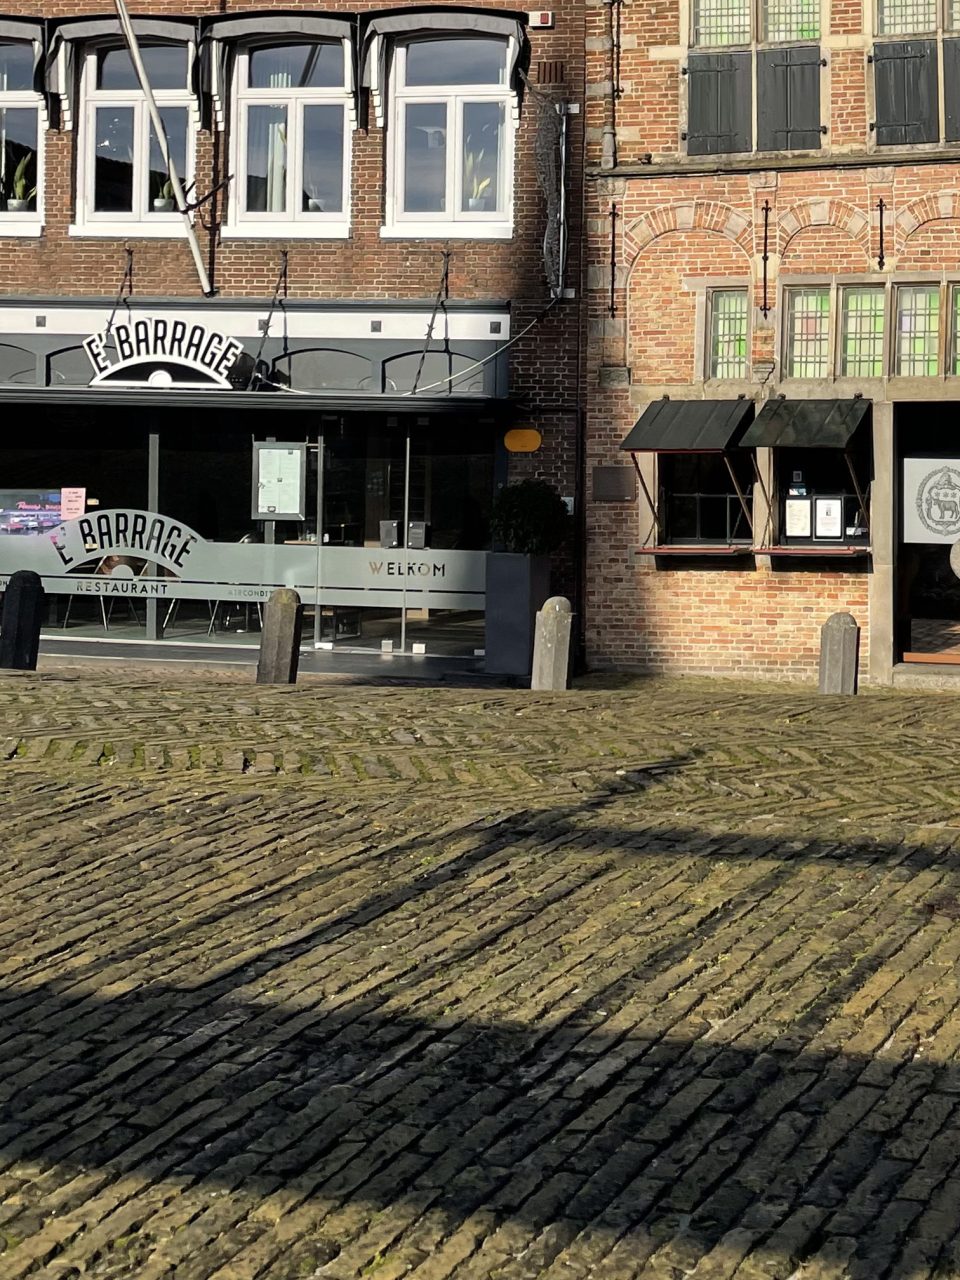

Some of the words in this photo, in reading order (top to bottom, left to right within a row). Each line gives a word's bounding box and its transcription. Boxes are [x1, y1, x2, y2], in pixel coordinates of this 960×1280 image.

[115, 319, 240, 377] BARRAGE
[78, 513, 198, 569] BARRAGE
[369, 561, 446, 577] WELKOM
[76, 581, 168, 595] RESTAURANT
